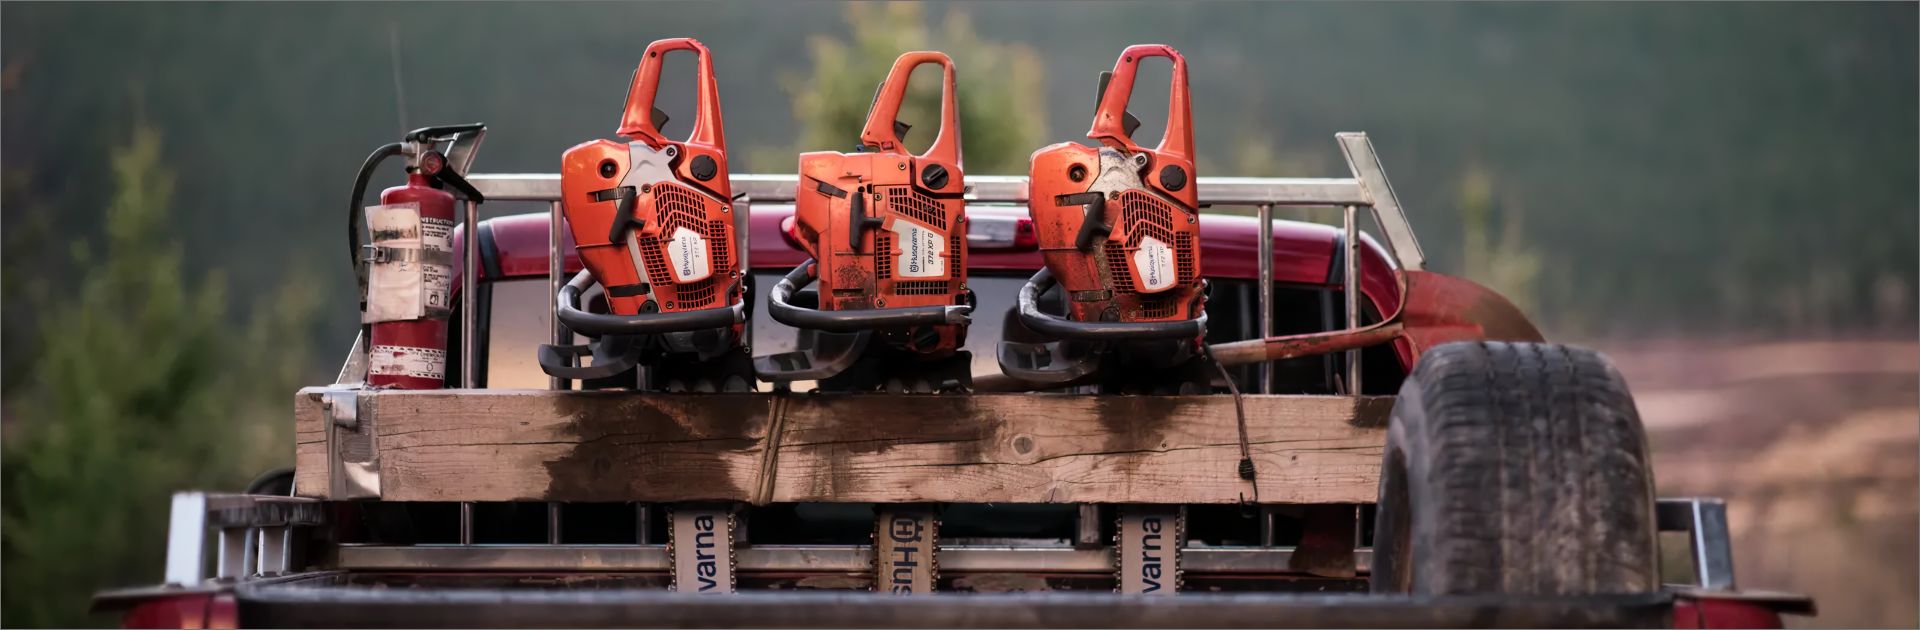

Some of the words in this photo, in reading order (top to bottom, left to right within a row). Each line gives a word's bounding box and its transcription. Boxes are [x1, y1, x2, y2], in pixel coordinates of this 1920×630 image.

[928, 240, 934, 250] XP
[695, 515, 717, 592] varna
[1142, 518, 1162, 594] varna
